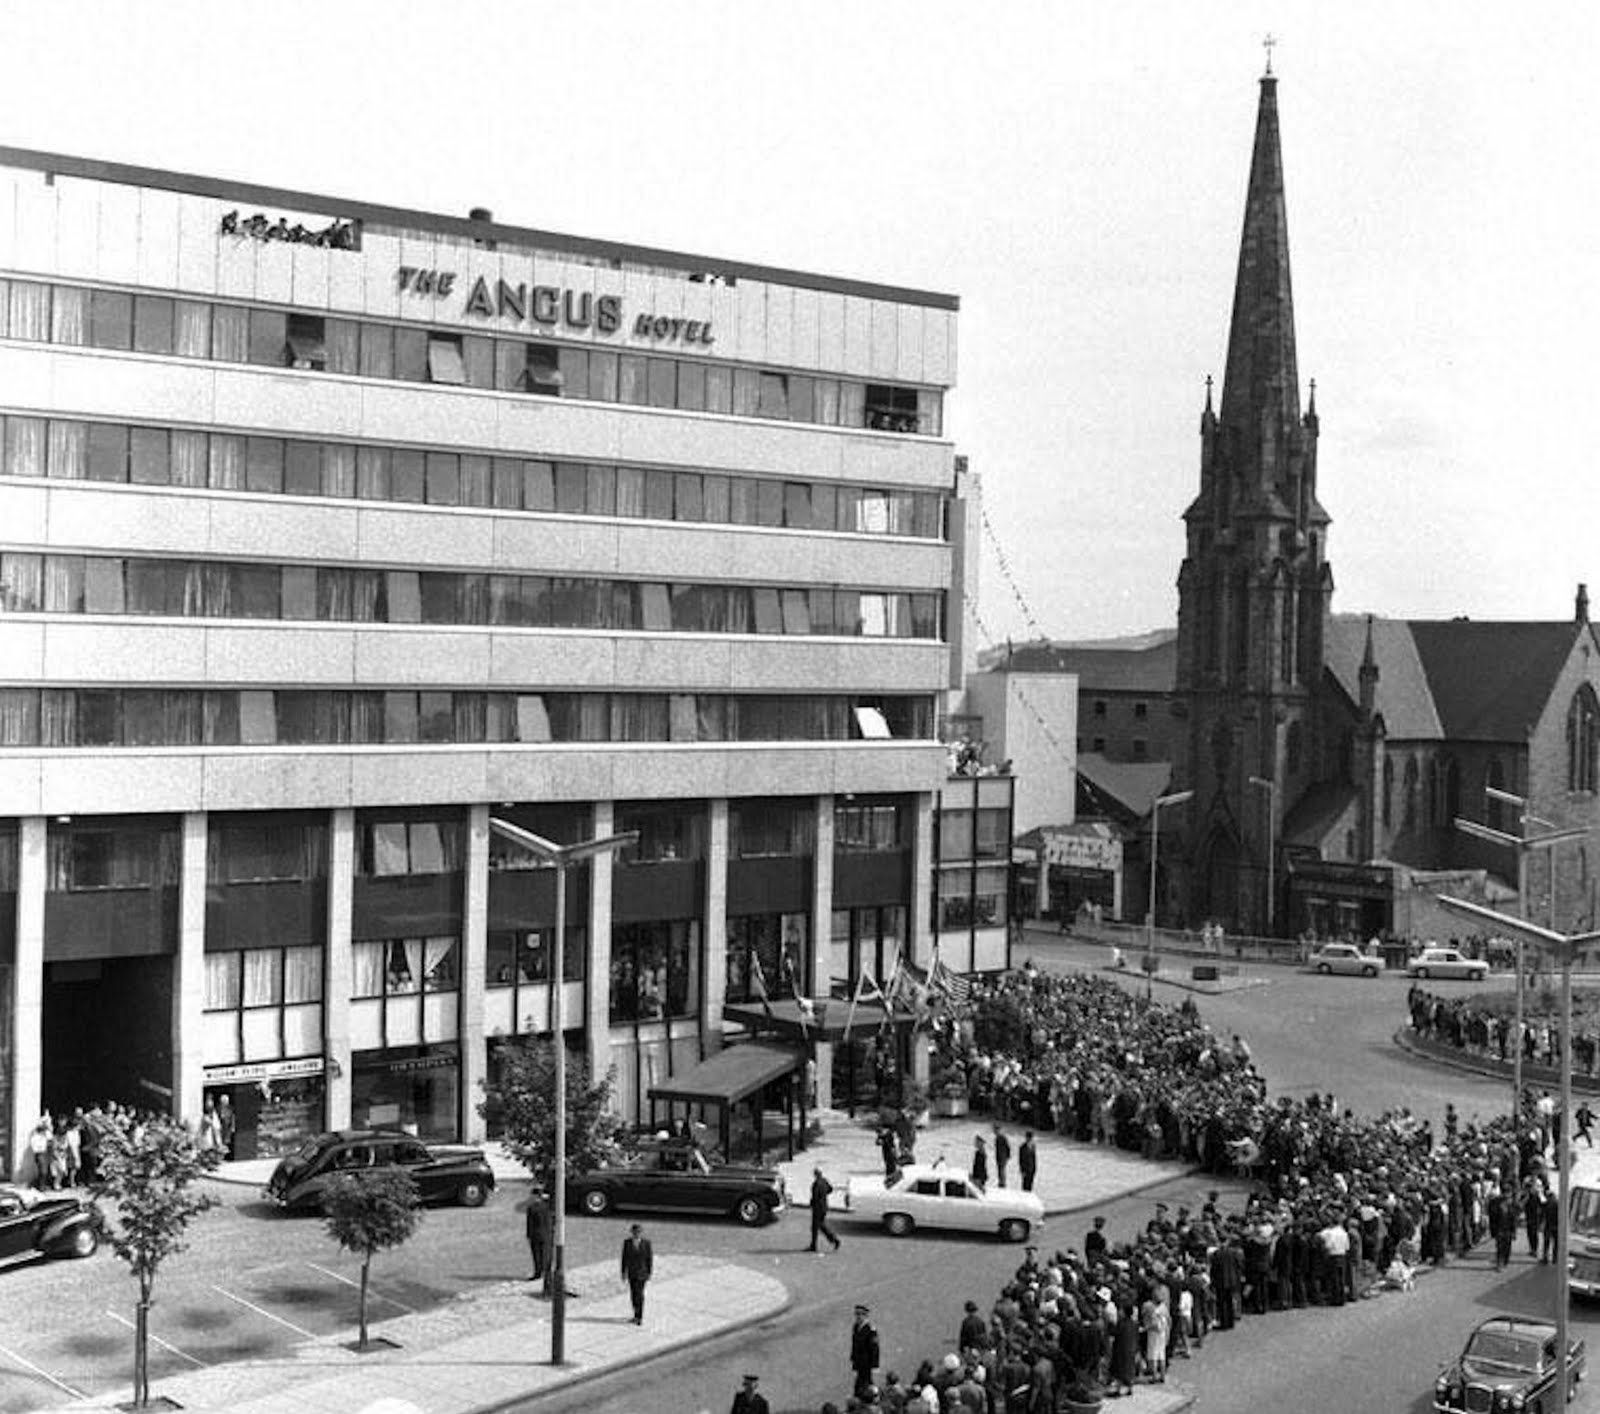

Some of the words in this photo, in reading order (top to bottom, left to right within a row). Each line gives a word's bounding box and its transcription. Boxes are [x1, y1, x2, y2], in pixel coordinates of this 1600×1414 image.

[398, 266, 457, 296] THE
[465, 275, 621, 334] ANGUS
[635, 313, 715, 344] HOTEL
